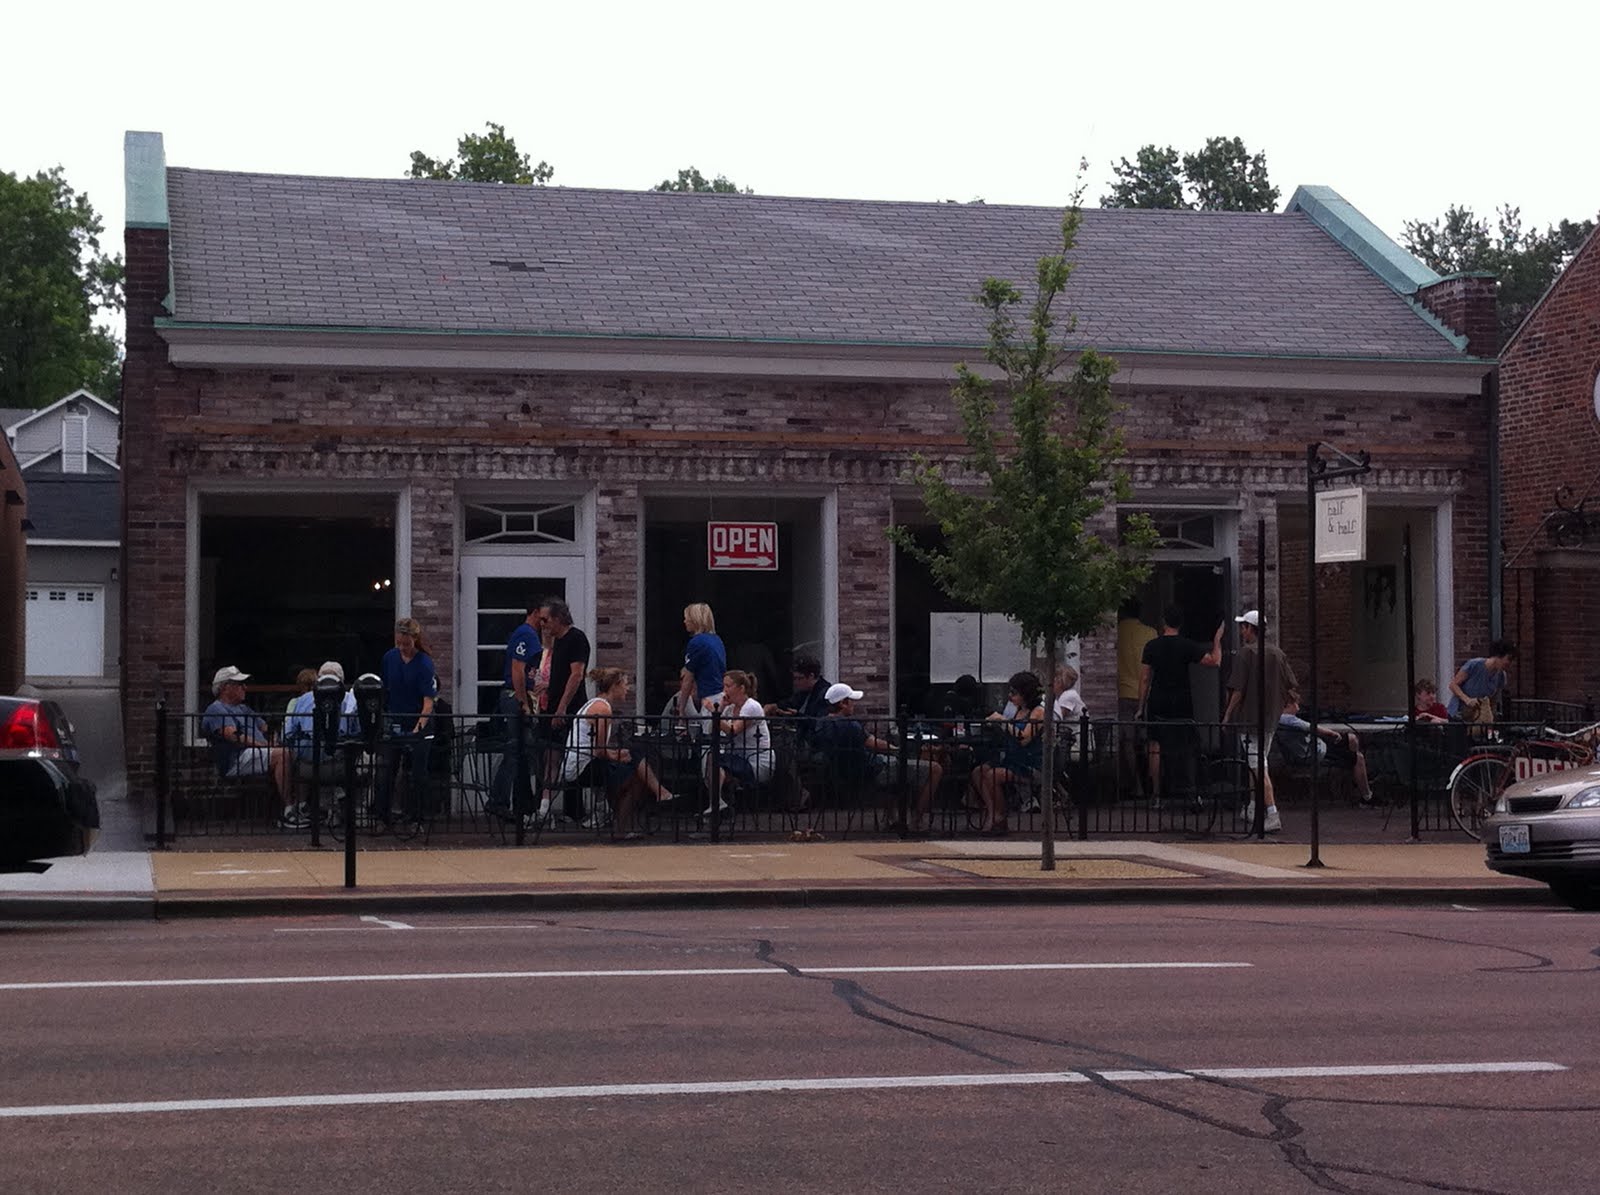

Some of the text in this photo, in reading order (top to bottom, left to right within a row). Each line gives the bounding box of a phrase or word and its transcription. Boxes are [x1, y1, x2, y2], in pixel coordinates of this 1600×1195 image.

[1327, 500, 1346, 516] half
[1328, 517, 1358, 535] & half
[713, 527, 773, 552] OPEN
[515, 641, 527, 656] &
